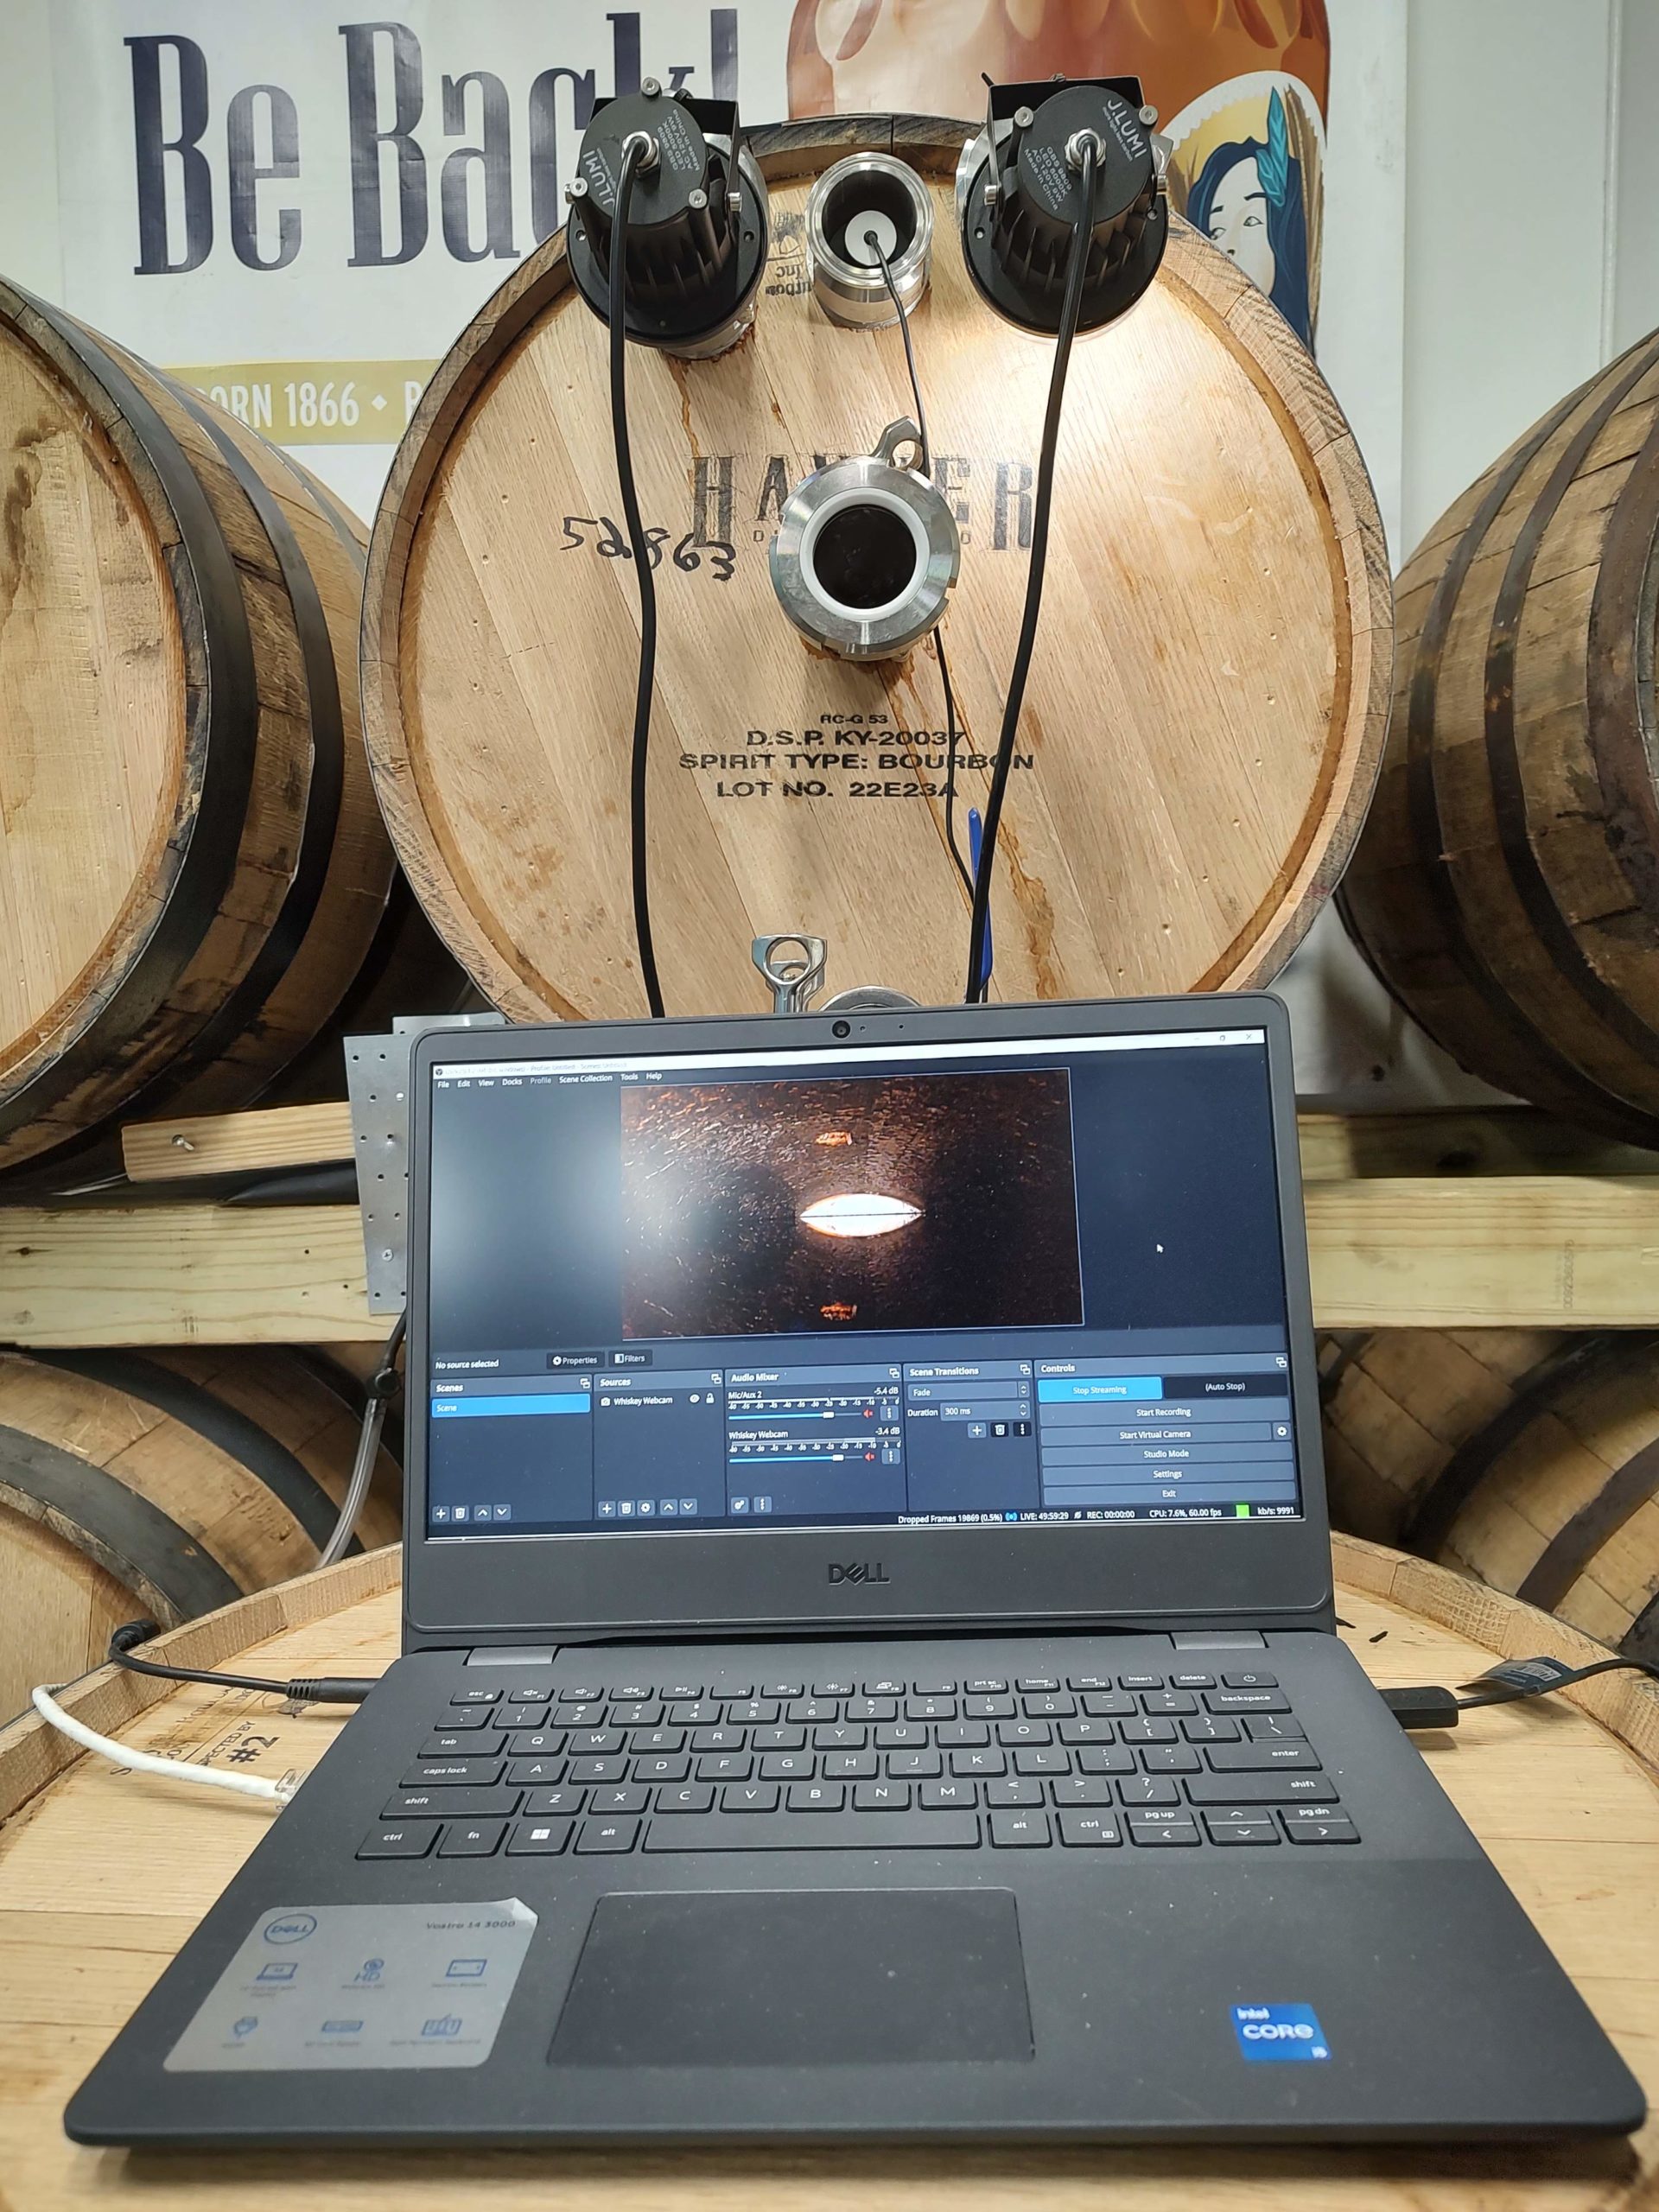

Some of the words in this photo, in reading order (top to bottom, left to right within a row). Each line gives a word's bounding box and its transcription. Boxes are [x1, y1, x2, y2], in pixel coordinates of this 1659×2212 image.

[1108, 99, 1147, 158] J.LUMI
[124, 35, 302, 276] Be
[1032, 149, 1042, 162] AC
[1039, 148, 1052, 167] LED
[1024, 149, 1039, 174] Made
[1043, 183, 1058, 211] China
[196, 383, 273, 428] ORN
[284, 381, 359, 427] 1866
[690, 454, 1033, 550] HAER
[868, 714, 888, 725] 53
[835, 730, 965, 747] KY-20037
[679, 753, 775, 770] SPIRIT
[784, 753, 869, 770] TYPE:
[716, 781, 773, 798] LOT
[782, 780, 834, 798] NO.
[849, 781, 960, 798] 22E23A
[530, 1077, 551, 1085] Profile
[580, 1074, 613, 1083] Collection
[620, 1072, 639, 1081] Tools
[645, 1071, 662, 1082] Help
[563, 1355, 598, 1366] Properties
[625, 1354, 645, 1363] Filters
[435, 1361, 444, 1370] No
[445, 1361, 470, 1370] source
[470, 1358, 499, 1369] selected
[1040, 1363, 1076, 1373] Controls
[909, 1367, 931, 1376] Scene
[933, 1365, 979, 1376] Transitions
[601, 1377, 632, 1387] Sources
[731, 1372, 754, 1382] Audio
[755, 1372, 779, 1381] Mixer
[435, 1383, 464, 1393] Scenes
[889, 1386, 899, 1395] dB
[1072, 1386, 1090, 1395] Stop
[1090, 1384, 1127, 1395] Streaming
[1205, 1382, 1225, 1392] (Auto
[1226, 1382, 1246, 1392] Stop)
[728, 1391, 755, 1400] Mic/Aux
[913, 1388, 931, 1397] Fade
[613, 1396, 642, 1407] Whiskey
[643, 1395, 673, 1405] Webcam
[436, 1403, 457, 1412] Scene
[907, 1408, 938, 1417] Duration
[944, 1407, 959, 1415] 300
[1136, 1408, 1154, 1417] Start
[1155, 1407, 1192, 1417] Recording
[728, 1430, 757, 1440] Whiskey
[758, 1429, 788, 1439] Webcam
[1120, 1431, 1137, 1440] Start
[1138, 1430, 1162, 1439] Virtual
[1163, 1429, 1192, 1439] Camera
[1143, 1450, 1166, 1459] Studio
[1168, 1449, 1189, 1458] Mode
[1153, 1470, 1182, 1479] Settings
[1162, 1489, 1176, 1498] Exit
[1020, 1512, 1037, 1521] LIVE:
[1038, 1511, 1069, 1521] 49:59:29
[1086, 1510, 1103, 1520] REC:
[1104, 1510, 1135, 1519] 00:00:00
[1149, 1509, 1167, 1518] CPU:
[1189, 1508, 1208, 1517] 60.00
[1210, 1508, 1222, 1518] fps
[1257, 1506, 1275, 1516] kb/s:
[1276, 1506, 1294, 1515] 9991
[898, 1515, 931, 1525] Dropped
[931, 1514, 957, 1523] Frames
[829, 1562, 891, 1586] DELL
[236, 1720, 256, 1732] BY
[226, 1736, 280, 1763] #2
[910, 1757, 918, 1765] J
[1037, 1754, 1046, 1763] L
[423, 1766, 447, 1775] caps
[530, 1764, 542, 1773] A
[594, 1763, 604, 1771] S
[679, 1791, 690, 1800] C
[746, 1790, 757, 1799] V
[810, 1789, 821, 1798] B
[875, 1788, 887, 1797] N
[941, 1787, 955, 1796] M
[550, 1794, 562, 1803] Z
[613, 1792, 626, 1802] X
[1145, 1810, 1160, 1820] pg
[1160, 1810, 1175, 1819] up
[1299, 1808, 1313, 1817] pg
[1314, 1807, 1330, 1815] dn
[1243, 2024, 1314, 2040] CORE
